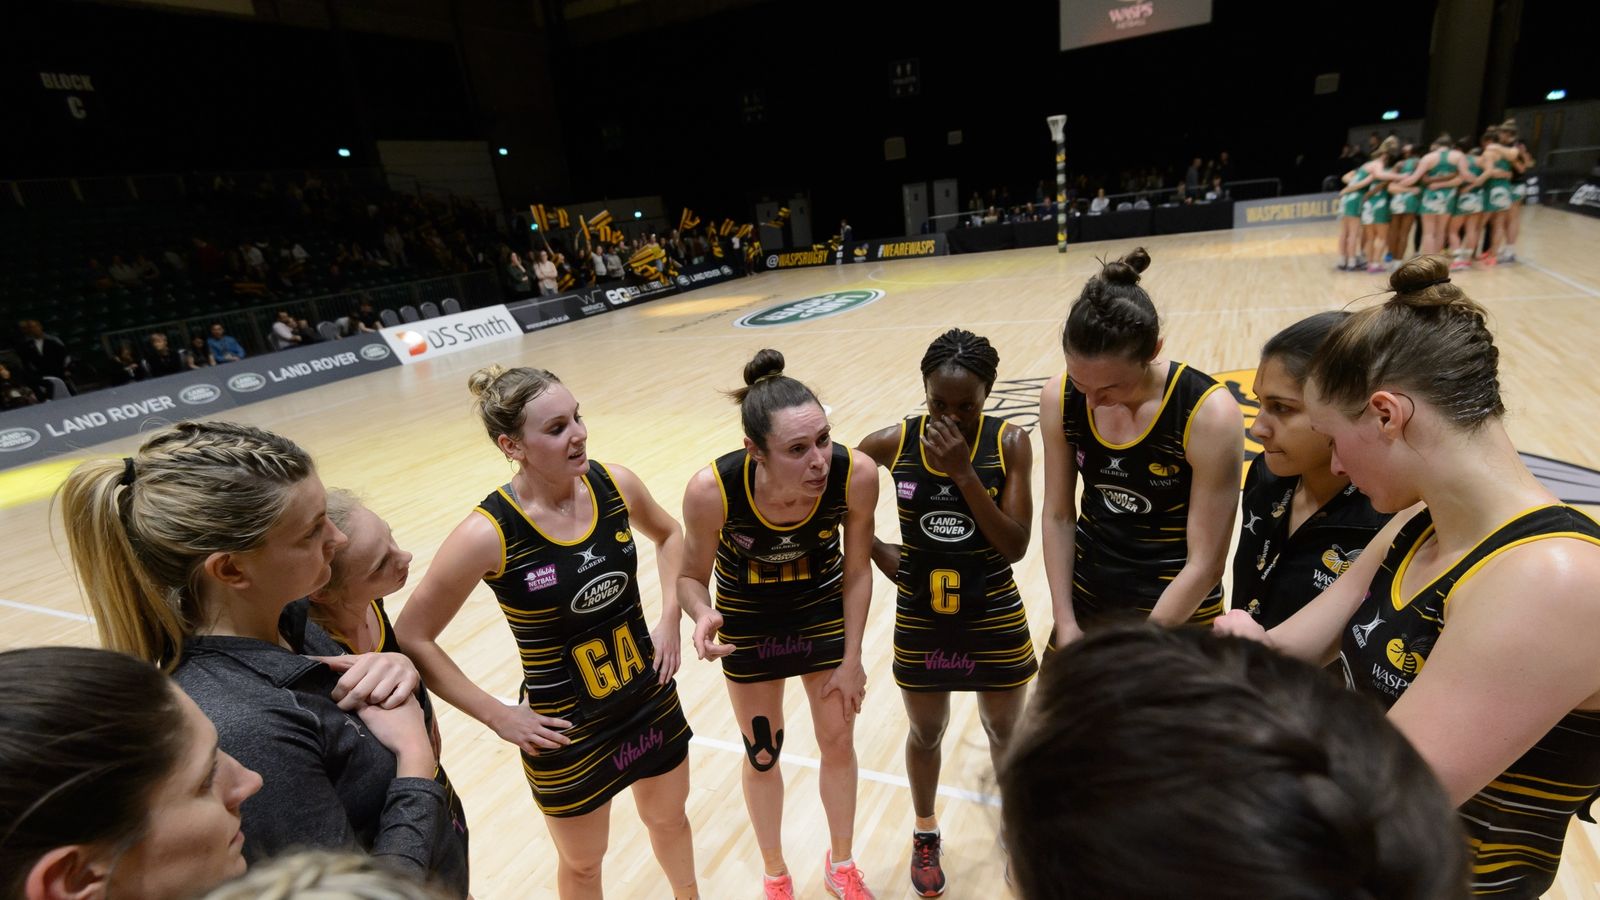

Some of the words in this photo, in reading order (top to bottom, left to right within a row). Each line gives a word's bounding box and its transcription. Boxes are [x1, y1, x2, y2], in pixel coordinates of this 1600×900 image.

[40, 71, 95, 92] BLOCK
[66, 95, 88, 120] C
[766, 250, 829, 268] @WASPSRUGBY
[877, 239, 936, 258] #WEAREWASPS
[427, 326, 459, 350] DS
[458, 315, 512, 342] Smith
[268, 362, 312, 382] LAND
[311, 351, 359, 372] ROVER
[45, 412, 108, 437] LAND
[107, 395, 176, 422] ROVER
[577, 556, 607, 573] GILBERT
[528, 575, 557, 587] NETBALL
[930, 568, 960, 615] C
[571, 621, 645, 700] GA
[755, 635, 813, 659] Vitality
[924, 647, 976, 676] Vitality
[613, 728, 664, 770] Vitality
